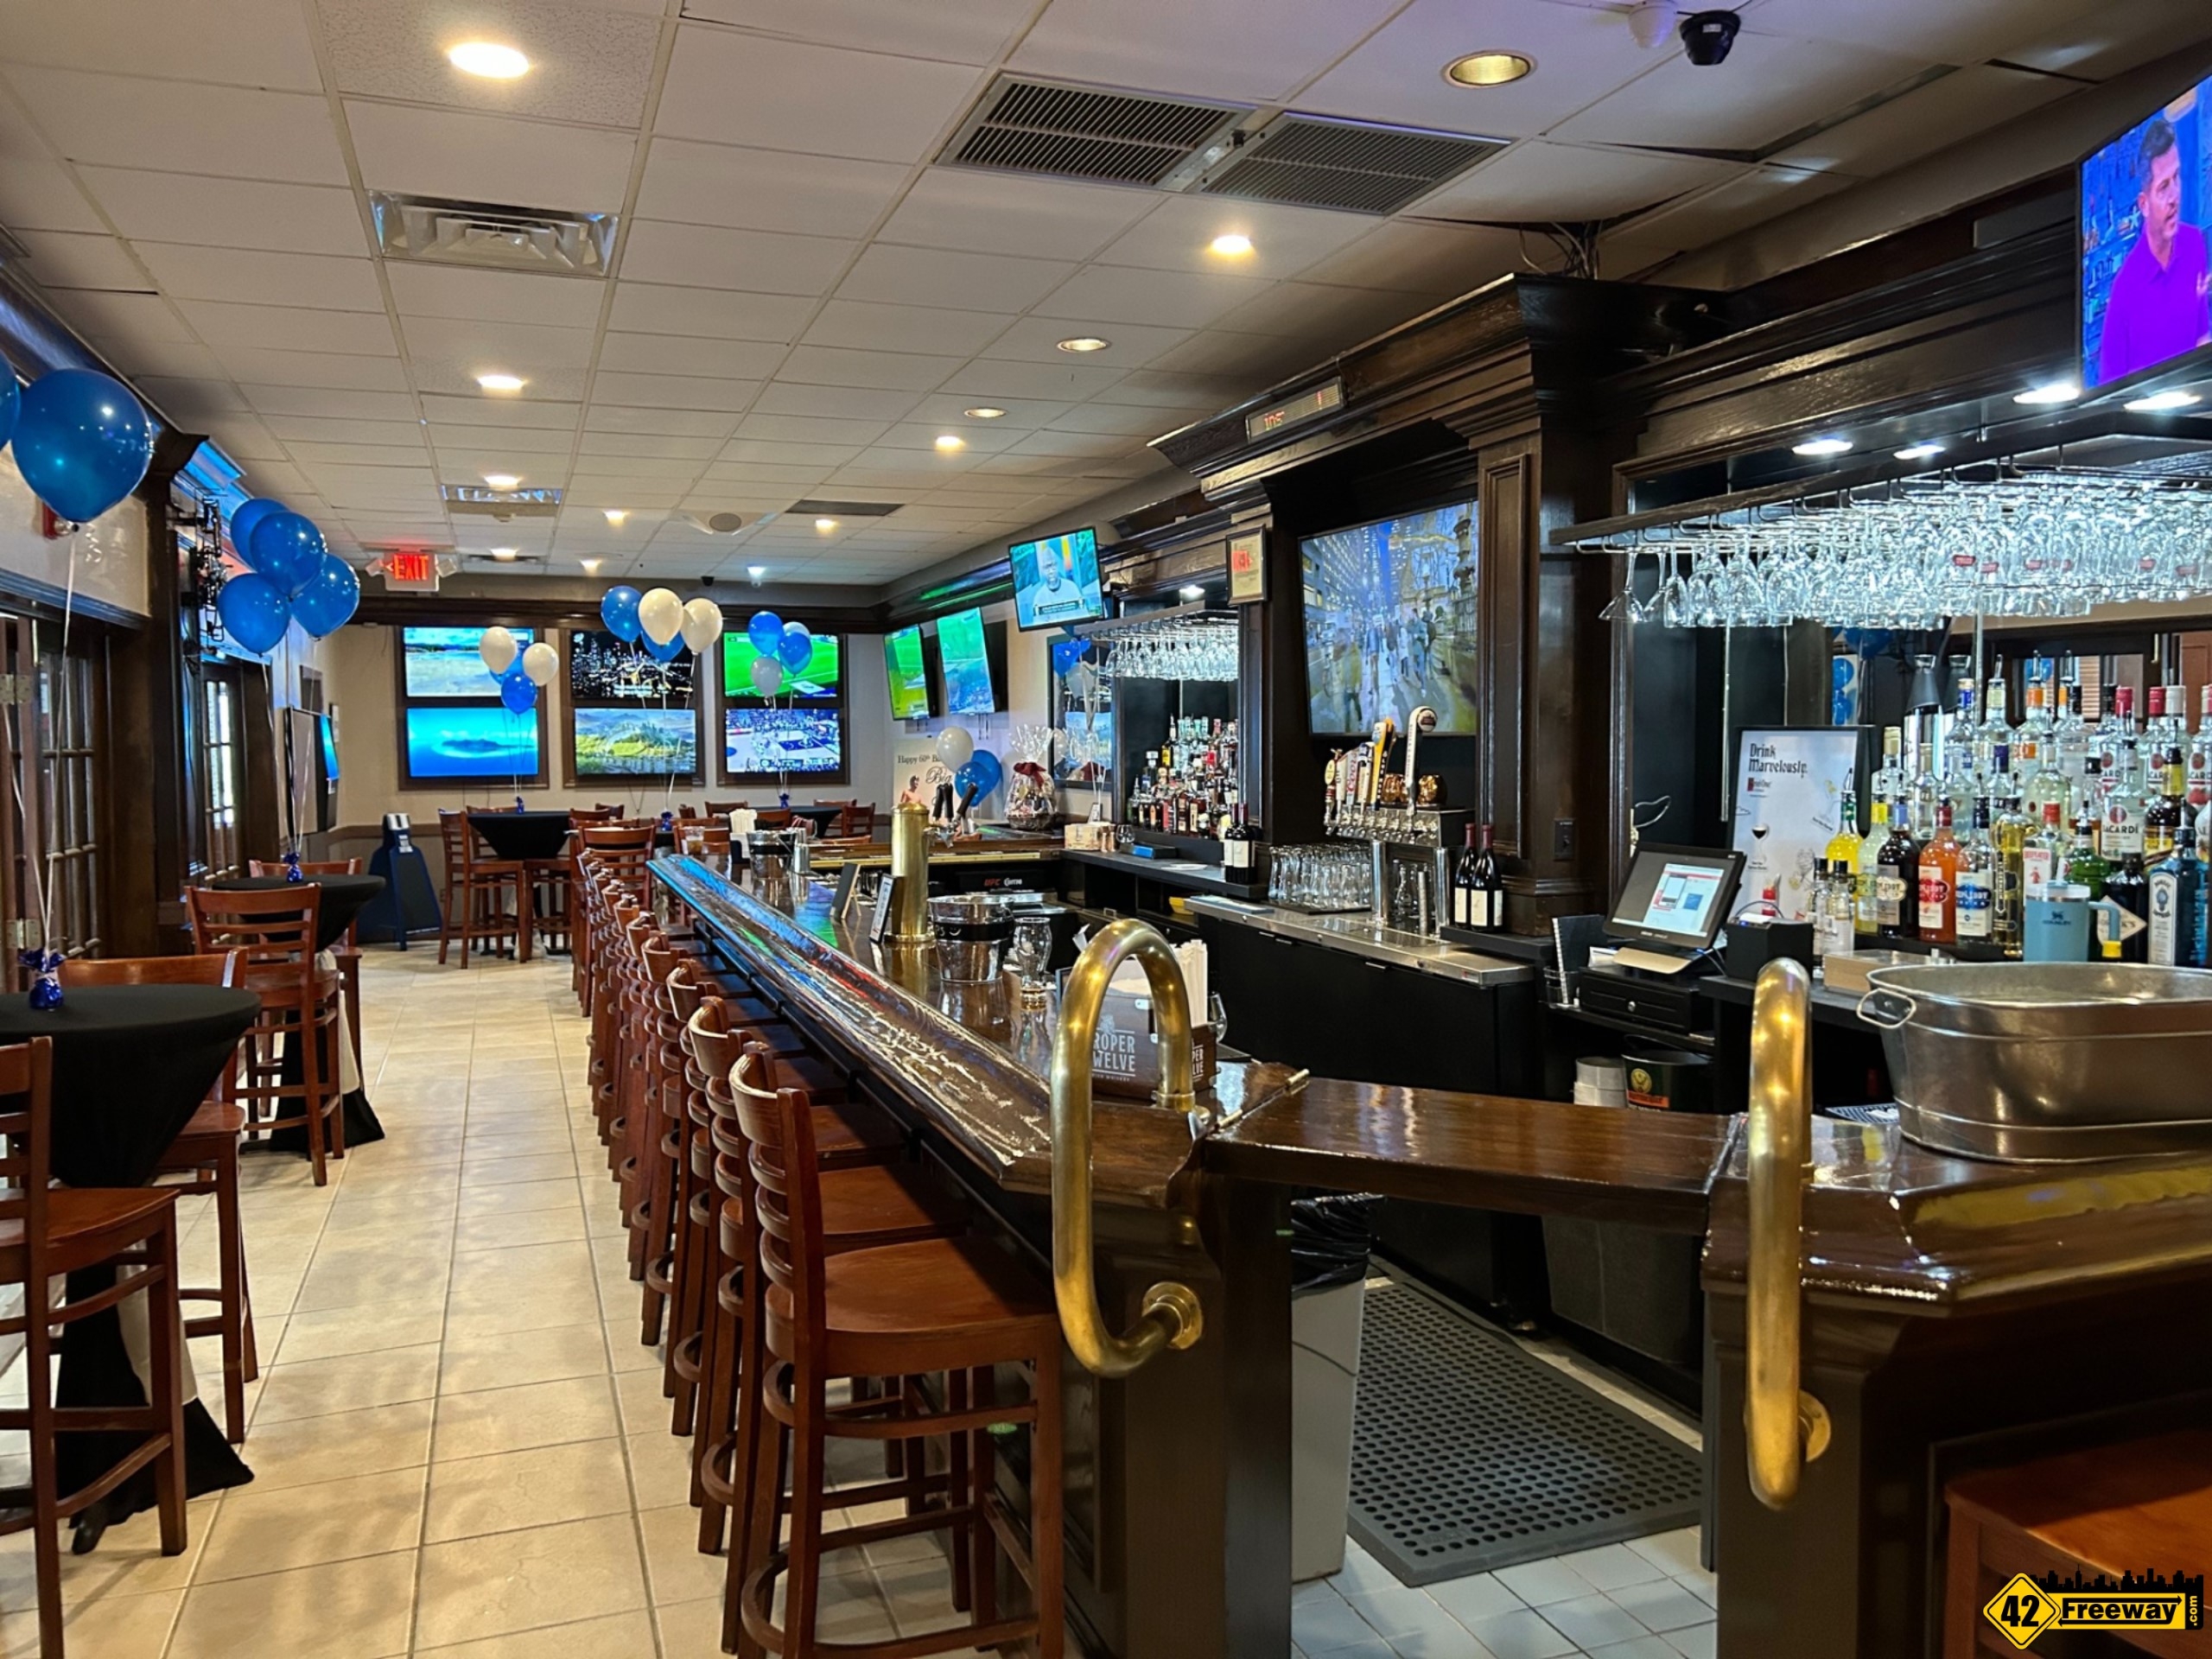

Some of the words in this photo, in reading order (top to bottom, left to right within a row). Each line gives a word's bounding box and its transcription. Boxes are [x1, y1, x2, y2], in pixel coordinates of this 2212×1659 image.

[394, 554, 429, 581] EXIT
[898, 754, 917, 765] Happy
[1750, 743, 1776, 759] Drink
[1093, 1032, 1135, 1054] ROPER
[1092, 1050, 1136, 1072] WELVE
